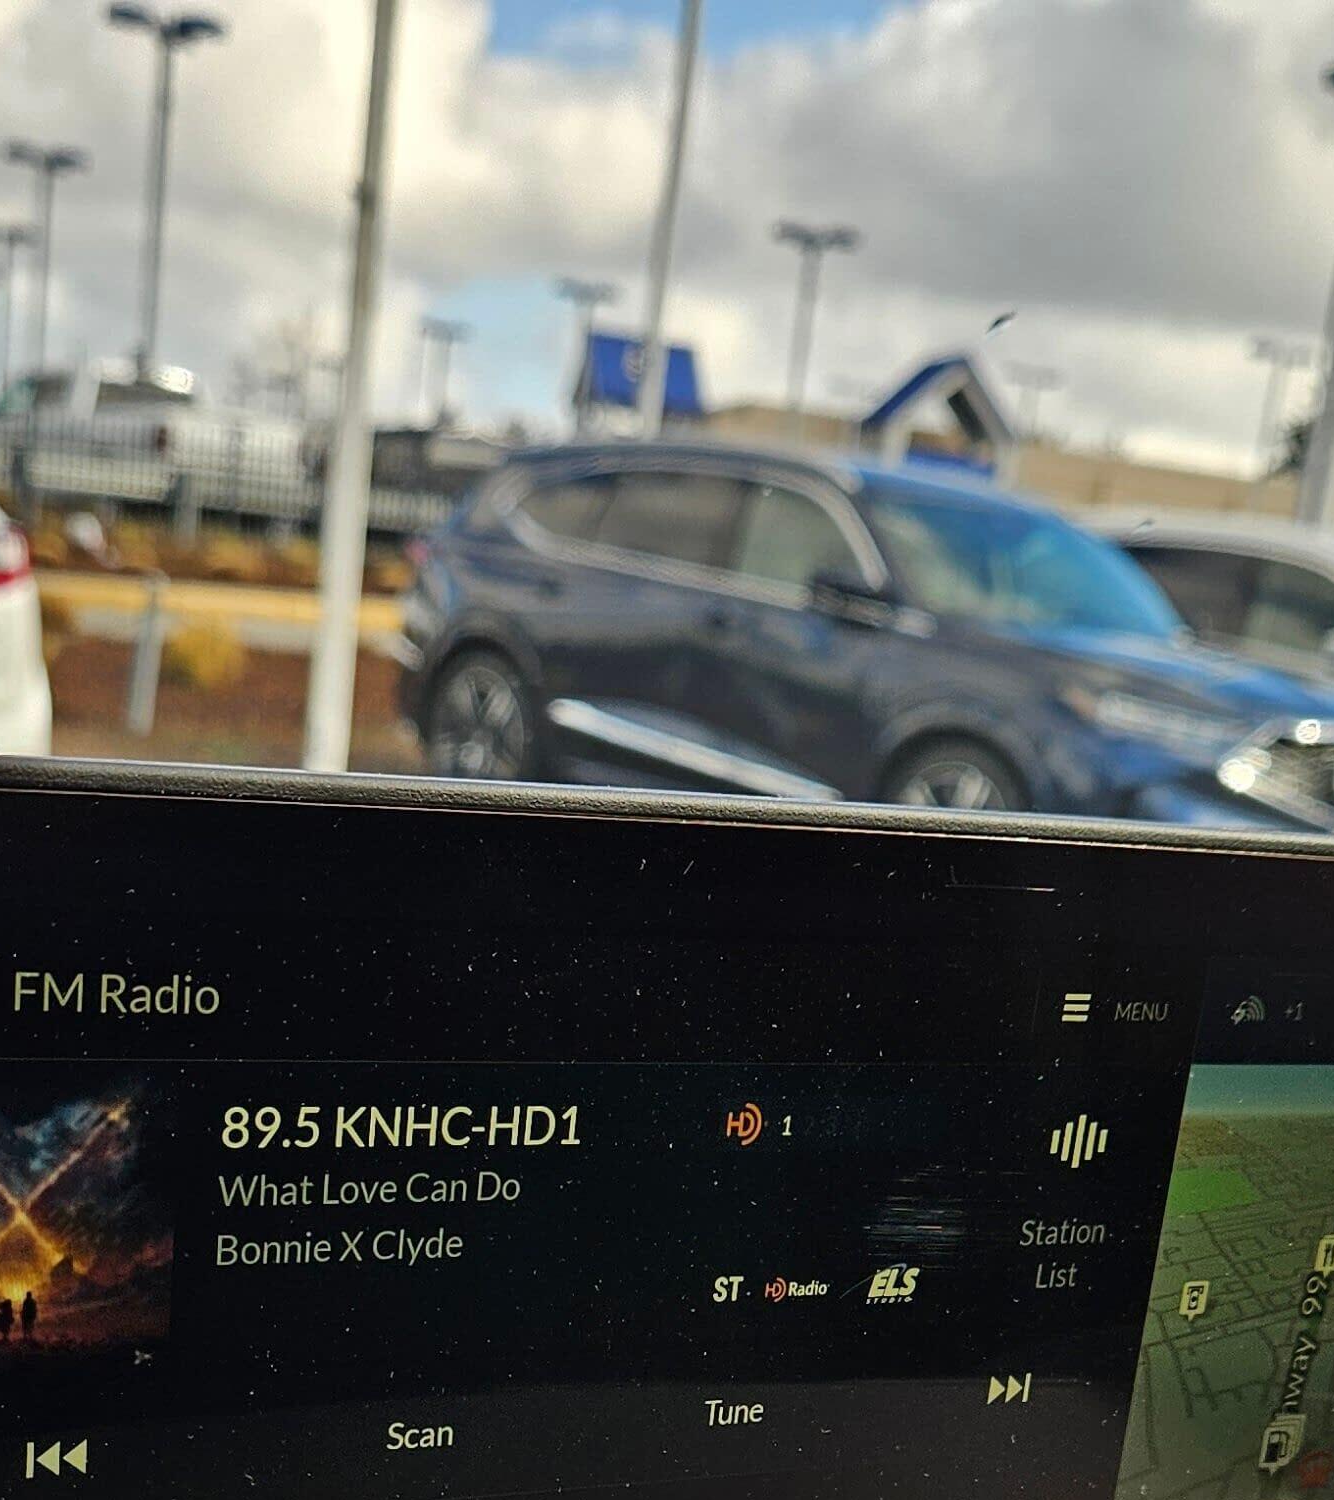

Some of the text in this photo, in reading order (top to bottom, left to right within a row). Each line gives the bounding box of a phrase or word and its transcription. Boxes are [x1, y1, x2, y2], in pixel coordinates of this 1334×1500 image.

[14, 971, 220, 1015] FM Radio
[1113, 1001, 1169, 1022] MENU
[221, 1105, 581, 1149] 89.5 KNHC-HD1
[781, 1115, 792, 1137] 1
[218, 1171, 521, 1207] What Love Can Do
[216, 1227, 464, 1266] Bonnie X Clyde
[1019, 1219, 1105, 1247] Station
[712, 1275, 745, 1303] ST
[787, 1279, 828, 1297] Radio
[868, 1267, 920, 1299] ELS
[1035, 1261, 1078, 1289] List
[1302, 1275, 1329, 1317] 99
[704, 1399, 764, 1426] Tune
[386, 1422, 454, 1450] Scan
